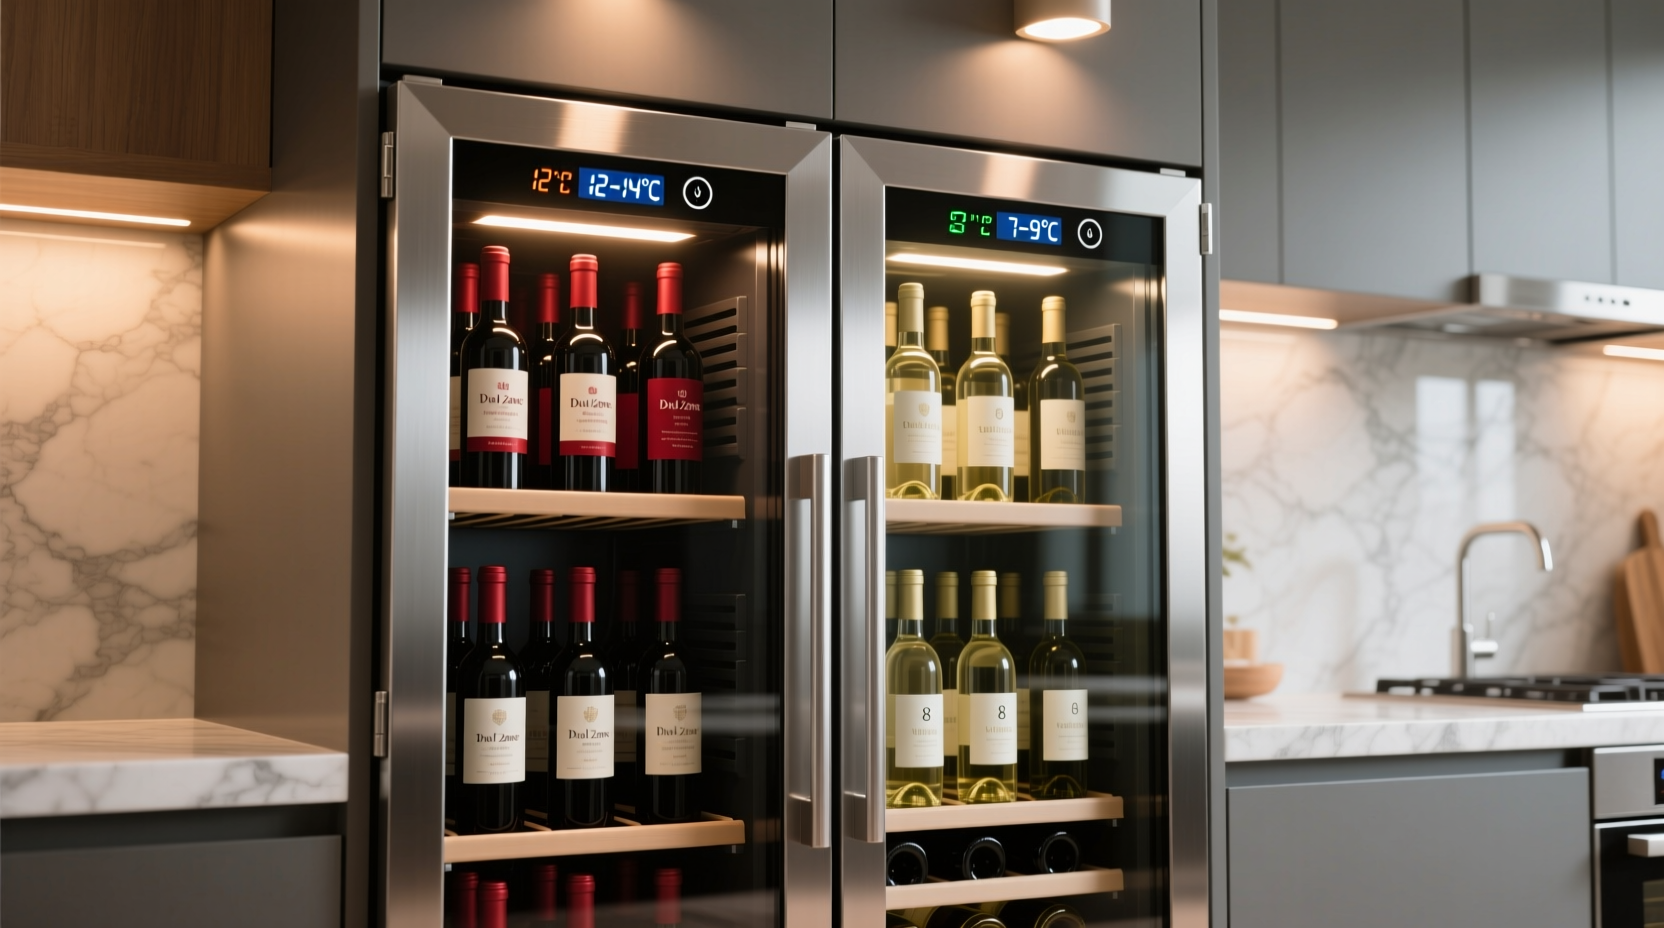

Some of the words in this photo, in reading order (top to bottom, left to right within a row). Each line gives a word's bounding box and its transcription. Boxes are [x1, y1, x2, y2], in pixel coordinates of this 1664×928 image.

[588, 173, 661, 202] 12-14°C
[1008, 216, 1059, 242] 7-9°C
[922, 706, 931, 722] 8
[998, 705, 1006, 720] 8
